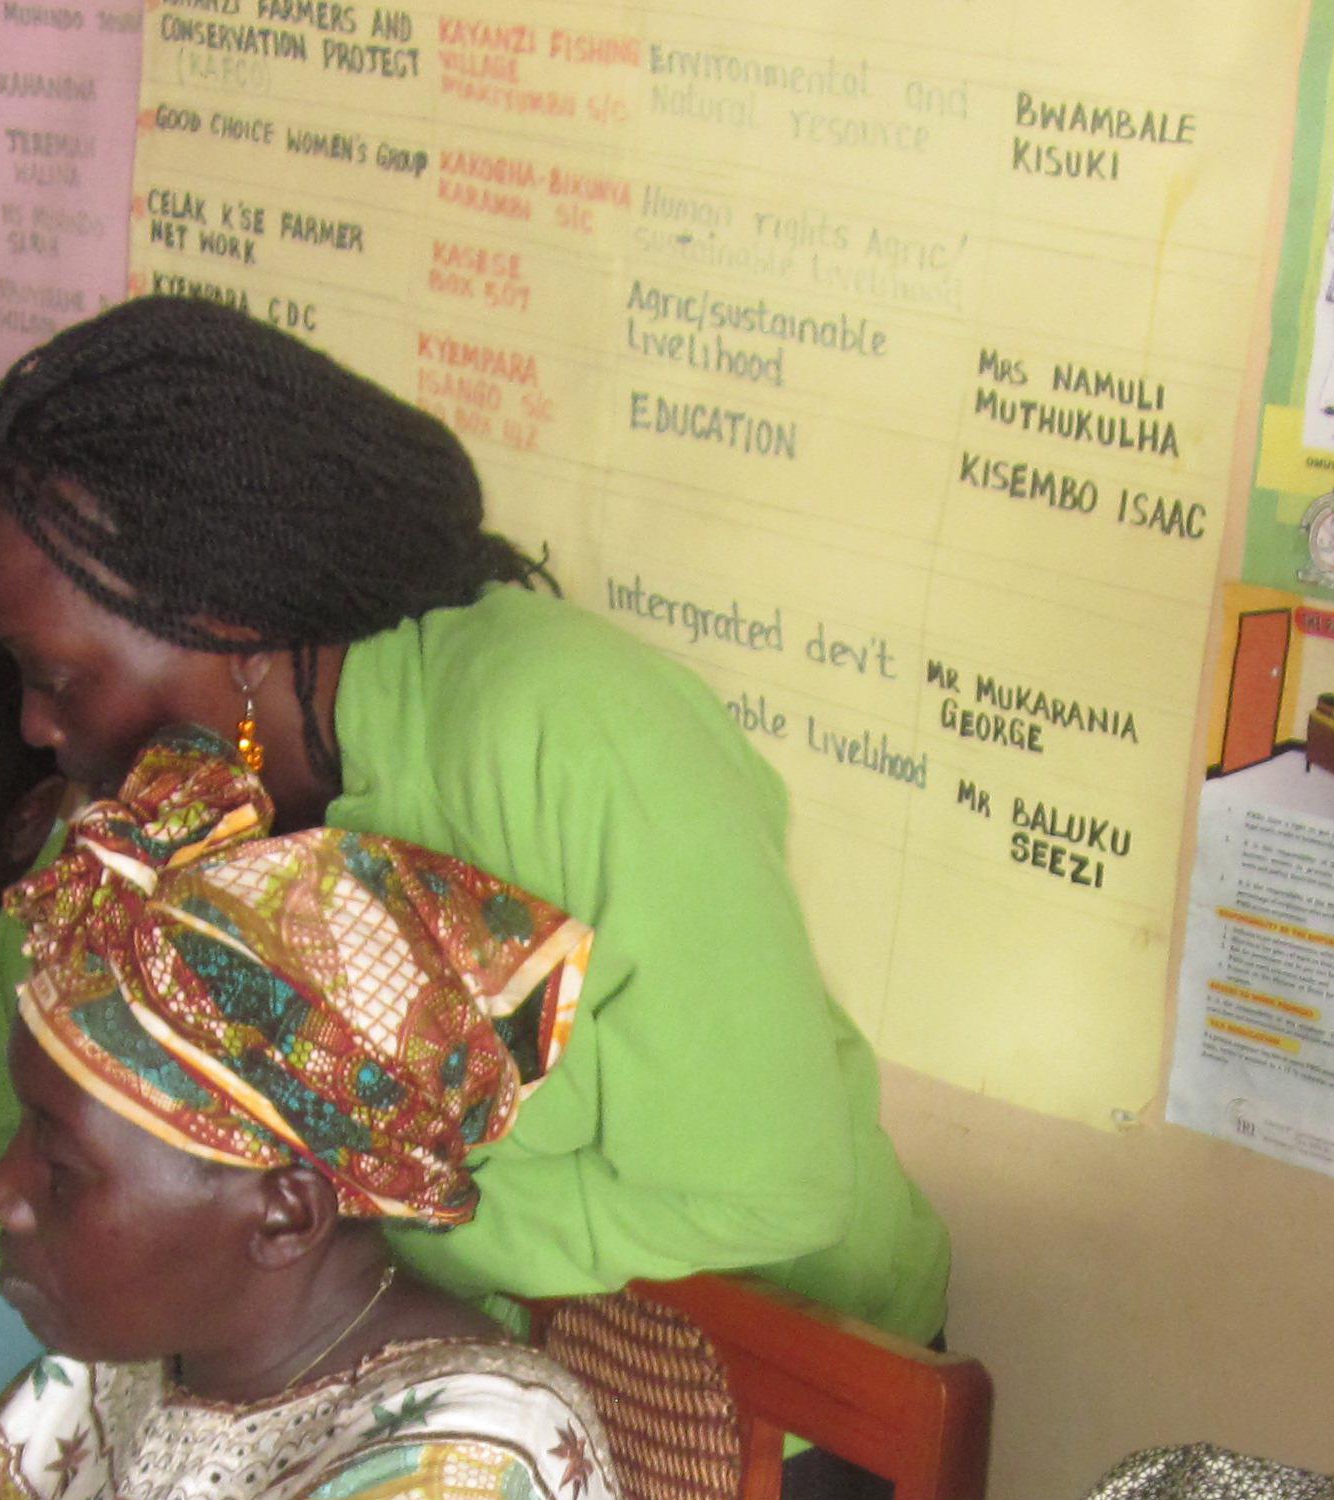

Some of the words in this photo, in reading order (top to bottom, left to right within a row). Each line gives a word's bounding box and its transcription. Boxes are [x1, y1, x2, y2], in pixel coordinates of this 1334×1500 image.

[160, 12, 308, 62] CONSERVATION
[371, 8, 413, 42] AND
[649, 43, 870, 99] Environmental
[155, 103, 202, 133] GOOD
[210, 112, 275, 145] CHOICE
[1014, 90, 1199, 146] BWAMBALE
[1012, 137, 1120, 181] KISUKI
[147, 187, 207, 225] CELAK
[279, 210, 364, 253] FARMER
[150, 219, 188, 251] NET
[199, 230, 257, 265] WORK
[1052, 361, 1165, 411] NAMULI
[629, 390, 798, 461] EDUCATION
[974, 387, 1180, 459] MUTHUKULHA
[960, 450, 1099, 516] KISEMBO
[1117, 487, 1208, 541] ISAAC
[726, 691, 788, 738] able
[940, 697, 1044, 753] GEORGE
[975, 674, 1140, 744] MUKARANIA
[1012, 796, 1132, 858] BALUKU
[1009, 831, 1105, 890] SEEZI
